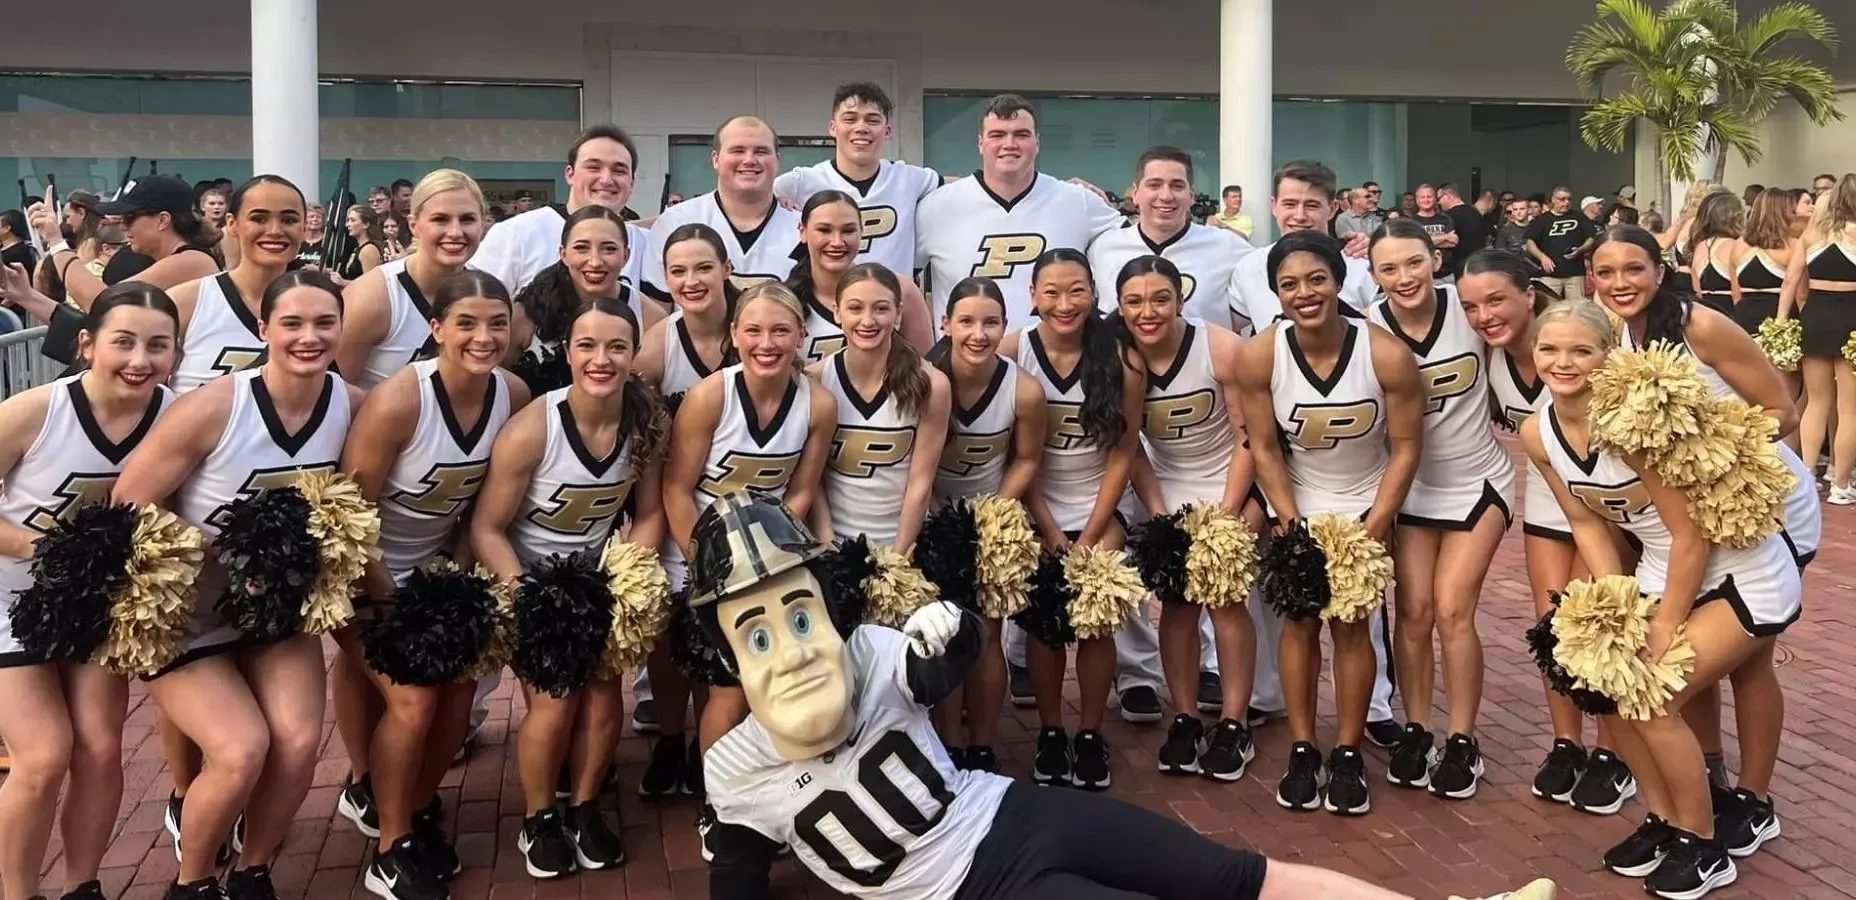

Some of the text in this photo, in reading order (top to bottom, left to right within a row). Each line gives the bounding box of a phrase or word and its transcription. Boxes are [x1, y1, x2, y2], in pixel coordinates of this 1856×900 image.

[859, 205, 897, 253] P
[1549, 219, 1578, 236] P
[970, 233, 1046, 279] P
[1418, 352, 1480, 413] P
[1143, 387, 1215, 439] P
[1291, 398, 1379, 450] P
[699, 450, 804, 500] P
[829, 424, 916, 478] P
[938, 429, 1010, 476] P
[390, 460, 489, 516] P
[528, 482, 633, 536] P
[1568, 477, 1653, 523] P
[794, 730, 956, 887] 00
